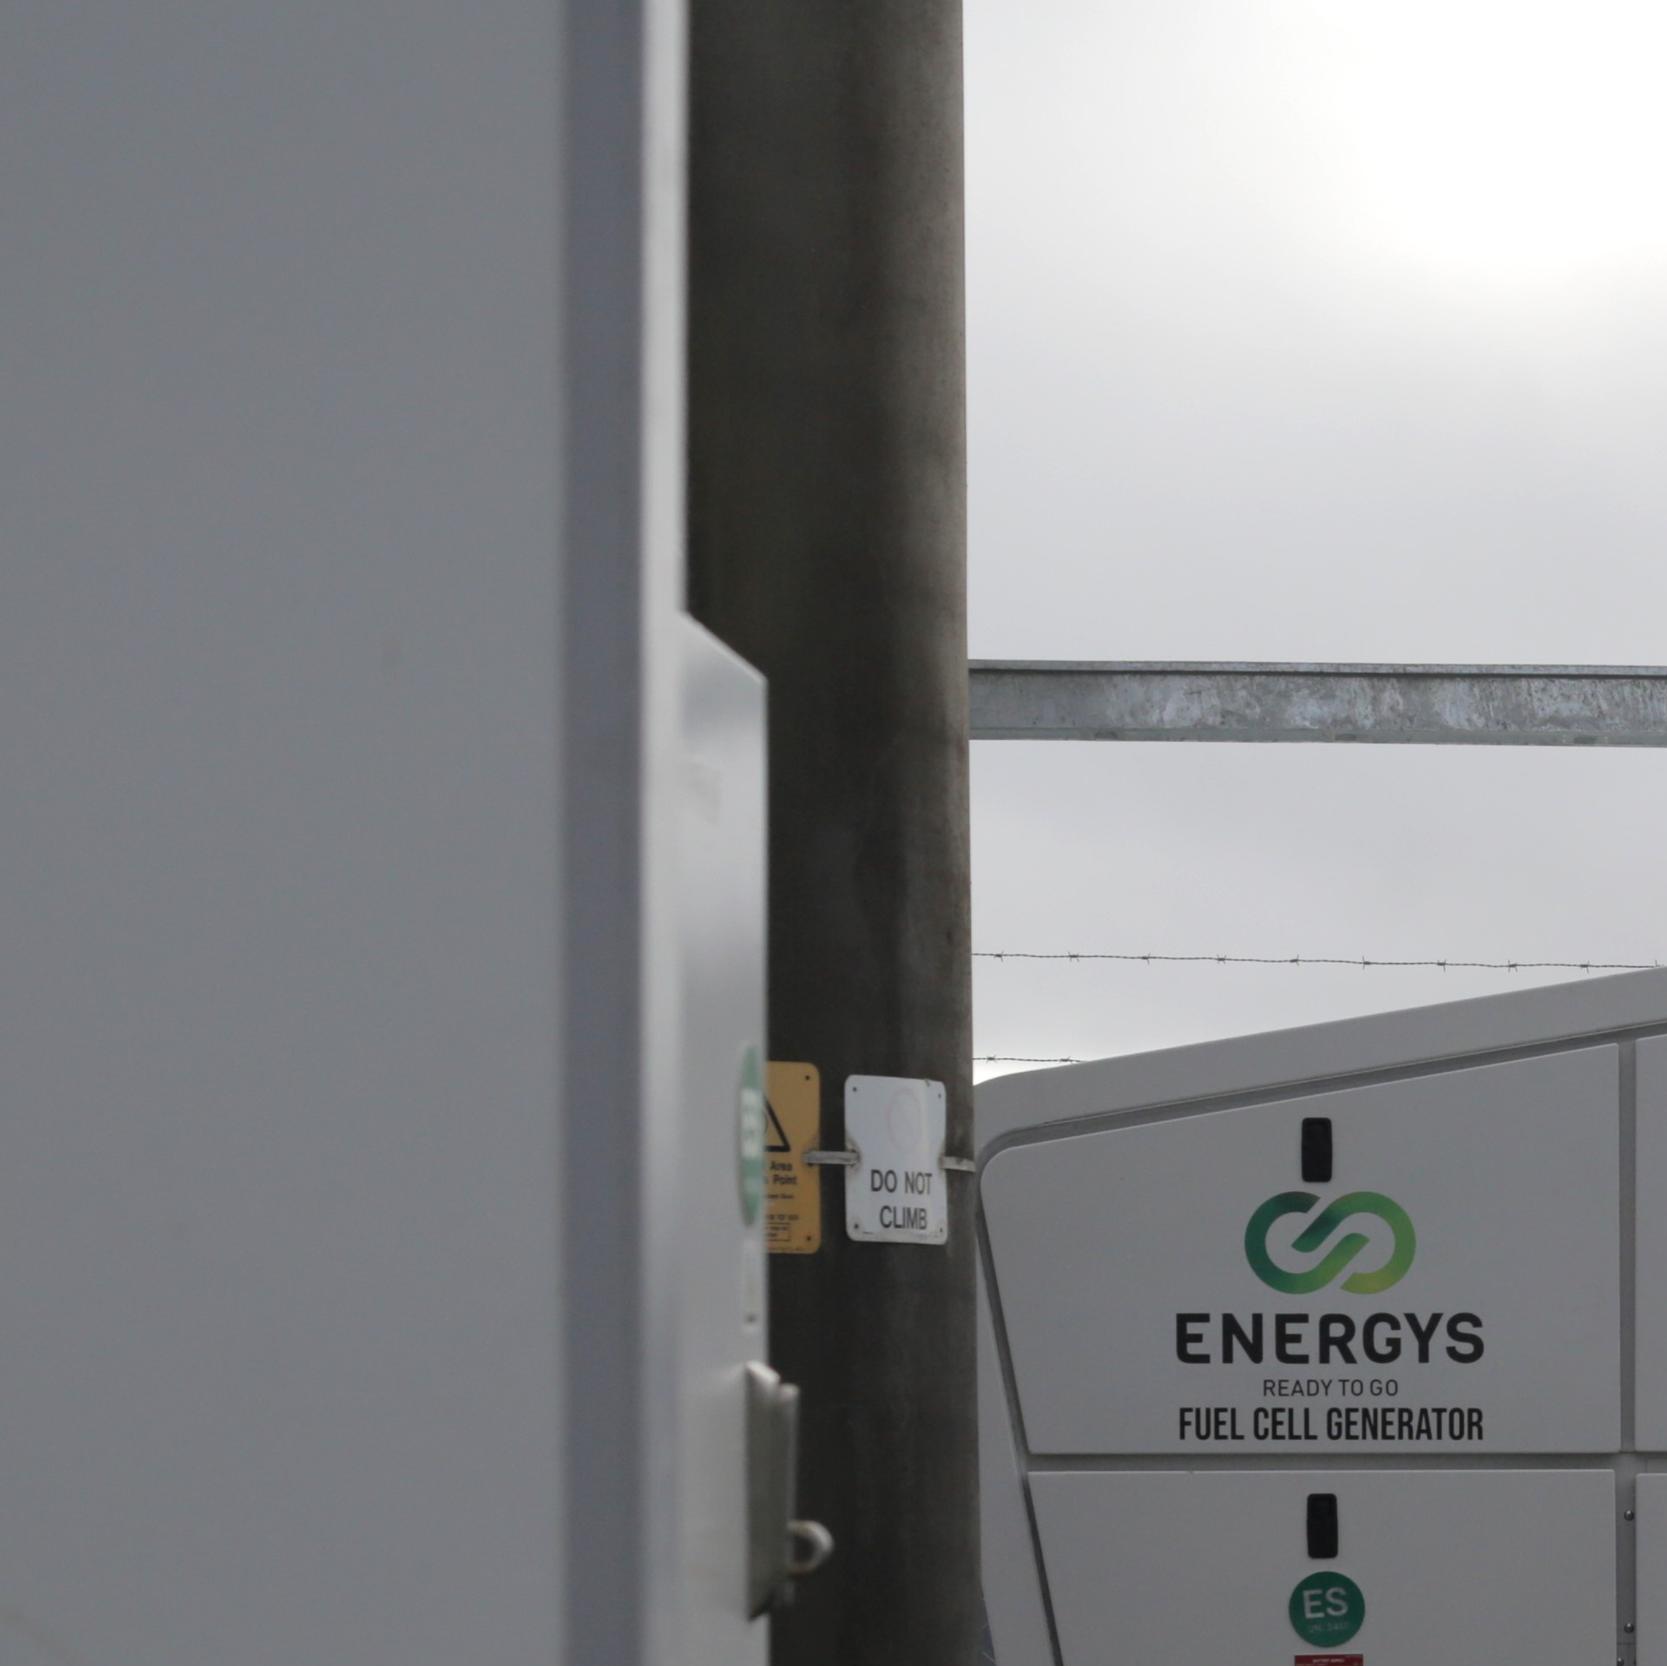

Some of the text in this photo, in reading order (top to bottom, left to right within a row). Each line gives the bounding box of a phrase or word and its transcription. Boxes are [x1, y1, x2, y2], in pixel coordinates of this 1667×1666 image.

[870, 1169, 933, 1195] DO NOT
[879, 1205, 928, 1231] CLIMB
[1175, 1312, 1485, 1365] ENERGYS
[1263, 1379, 1399, 1397] READY TO GO
[1179, 1406, 1484, 1441] FUEL CELL GENERATOR
[1302, 1586, 1349, 1619] ES
